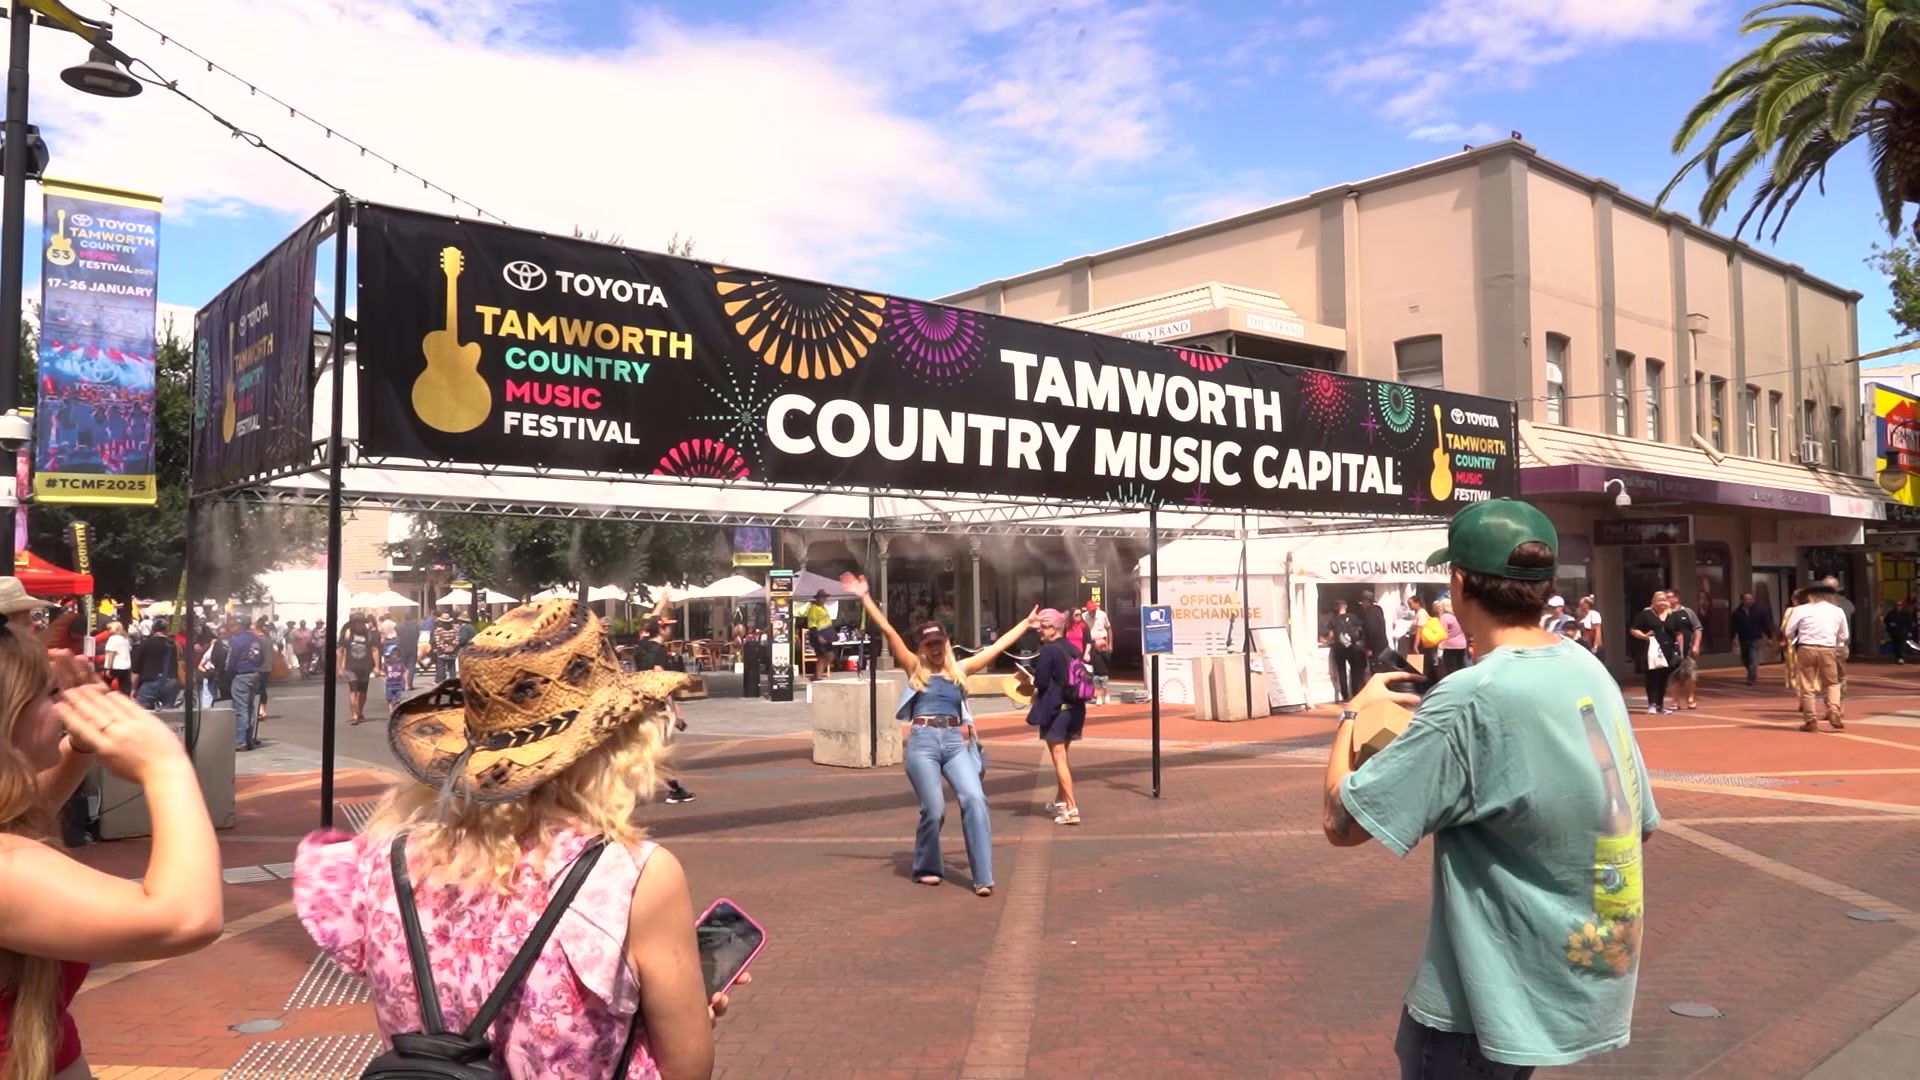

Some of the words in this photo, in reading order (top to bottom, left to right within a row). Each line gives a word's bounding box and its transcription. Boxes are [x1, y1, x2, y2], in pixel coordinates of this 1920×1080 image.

[97, 218, 154, 235] TOYOTA
[69, 227, 155, 247] TAMWORTH
[52, 249, 71, 259] 53
[80, 240, 137, 254] COUNTRY
[79, 260, 133, 274] FESTIVAL
[89, 282, 154, 297] JANUARY
[555, 270, 668, 308] TOYOTA
[475, 305, 693, 360] TAMWORTH
[1148, 321, 1189, 338] STRAND
[505, 347, 651, 384] COUNTRY
[505, 379, 602, 410] MUSIC
[1000, 348, 1283, 434] TAMWORTH
[503, 411, 640, 445] FESTIVAL
[1465, 412, 1499, 428] TOYOTA
[766, 393, 1080, 473] COUNTRY
[1094, 428, 1242, 485] MUSIC
[1253, 444, 1403, 496] CAPITAL
[1445, 432, 1507, 456] TAMWORTH
[1455, 454, 1497, 470] COUNTRY
[45, 478, 146, 491] #TCMF2025
[1455, 471, 1484, 485] MUSIC
[75, 523, 90, 567] COUNTRY
[1330, 560, 1387, 575] OFFICIAL
